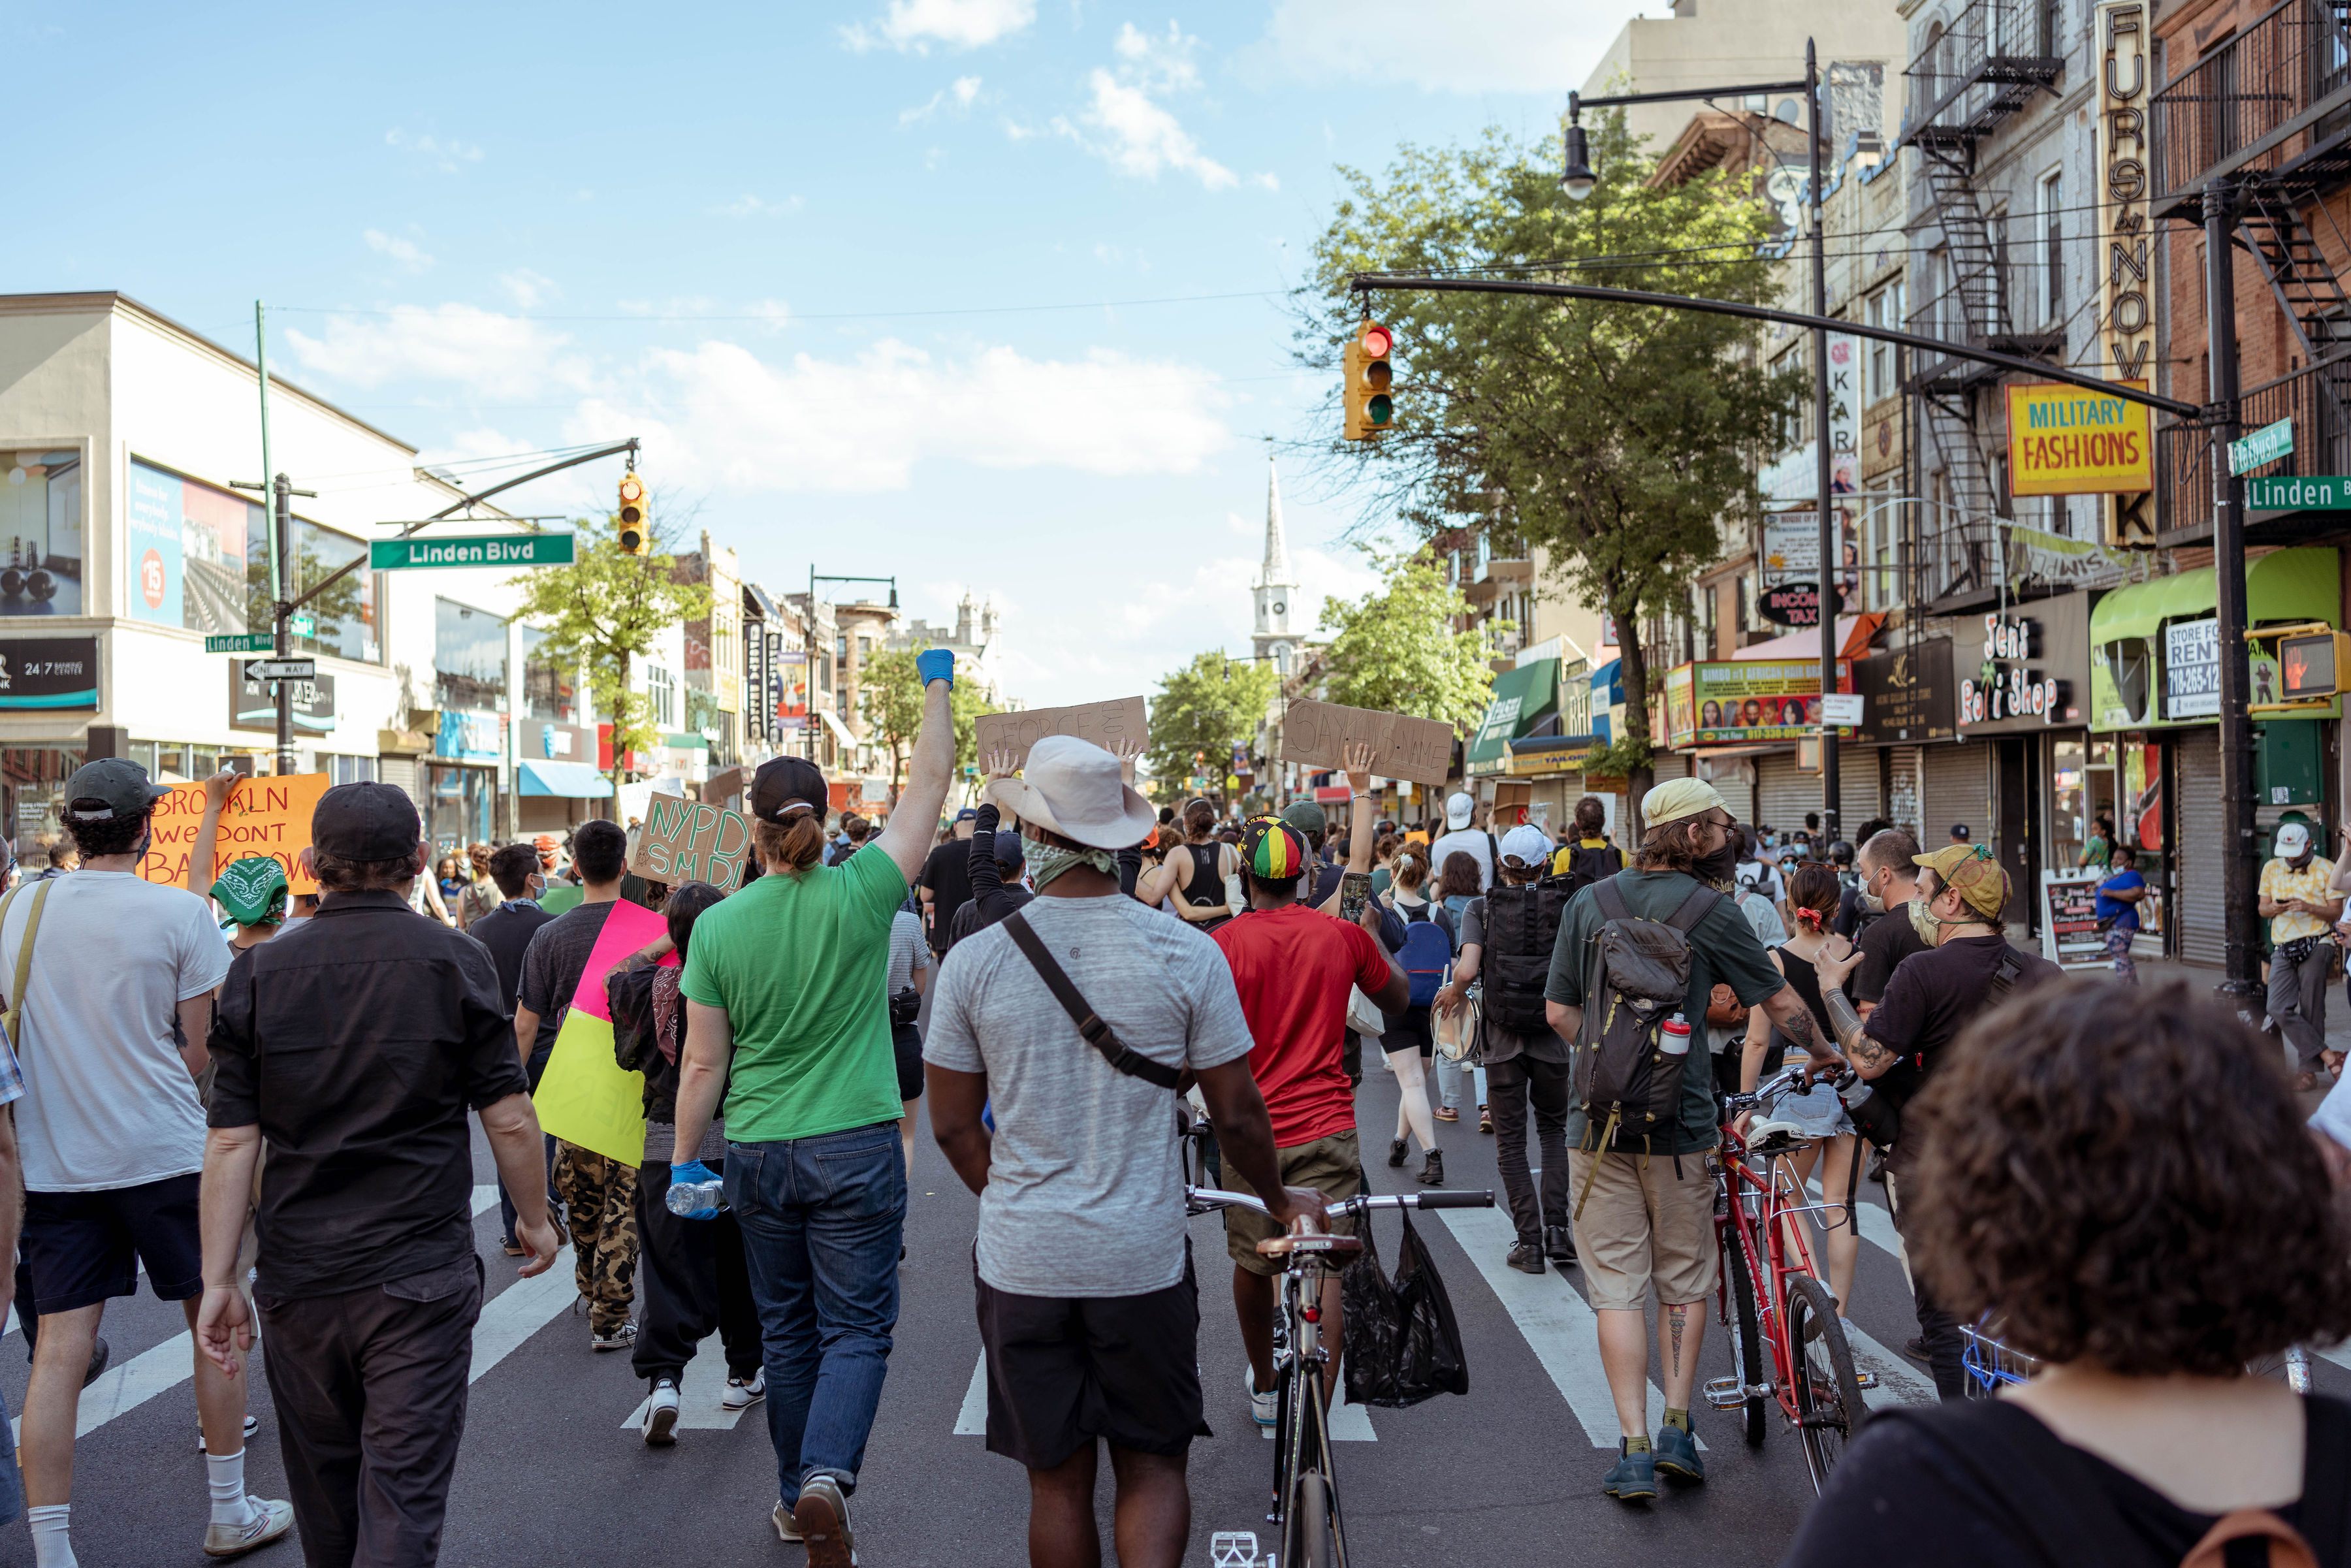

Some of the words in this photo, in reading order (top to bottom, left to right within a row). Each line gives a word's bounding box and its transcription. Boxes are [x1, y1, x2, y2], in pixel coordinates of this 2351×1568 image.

[2106, 4, 2144, 201] FURS
[2114, 205, 2143, 235] by
[2111, 239, 2154, 537] NOVK
[2028, 398, 2127, 428] MILITARY
[2023, 430, 2140, 470] FASHIONS
[2233, 430, 2279, 472] Flatbush
[2281, 425, 2289, 443] Av
[2253, 479, 2332, 506] Linden
[409, 542, 482, 563] Linden
[487, 541, 534, 560] Blvd
[1770, 592, 1819, 609] INCOM
[1787, 609, 1818, 623] TAX
[208, 636, 250, 652] Linden
[255, 635, 272, 645] Blvd
[1984, 613, 2029, 662] Jen's
[2171, 627, 2201, 645] STORE
[2205, 624, 2218, 639] FO
[2171, 640, 2218, 665] REN
[25, 662, 39, 675] 24
[44, 662, 53, 675] 7
[253, 664, 272, 674] ONE
[285, 664, 305, 674] WAY
[1702, 667, 1730, 682] BIMBO
[1746, 665, 1783, 680] AFRICAN
[1784, 665, 1804, 679] HAIR
[2168, 665, 2219, 696] 718-265-12
[2007, 668, 2057, 725] Shop
[1401, 729, 1448, 769] NAME
[153, 786, 288, 818] BROKLN
[216, 823, 286, 842] DONT
[650, 800, 749, 858] NYPD
[145, 851, 232, 884] BAK
[648, 843, 744, 895] SMD!
[1708, 876, 1735, 893] Blac
[1751, 1136, 1765, 1147] turbo
[1791, 1129, 1804, 1138] turbo
[658, 1380, 671, 1388] NIKE
